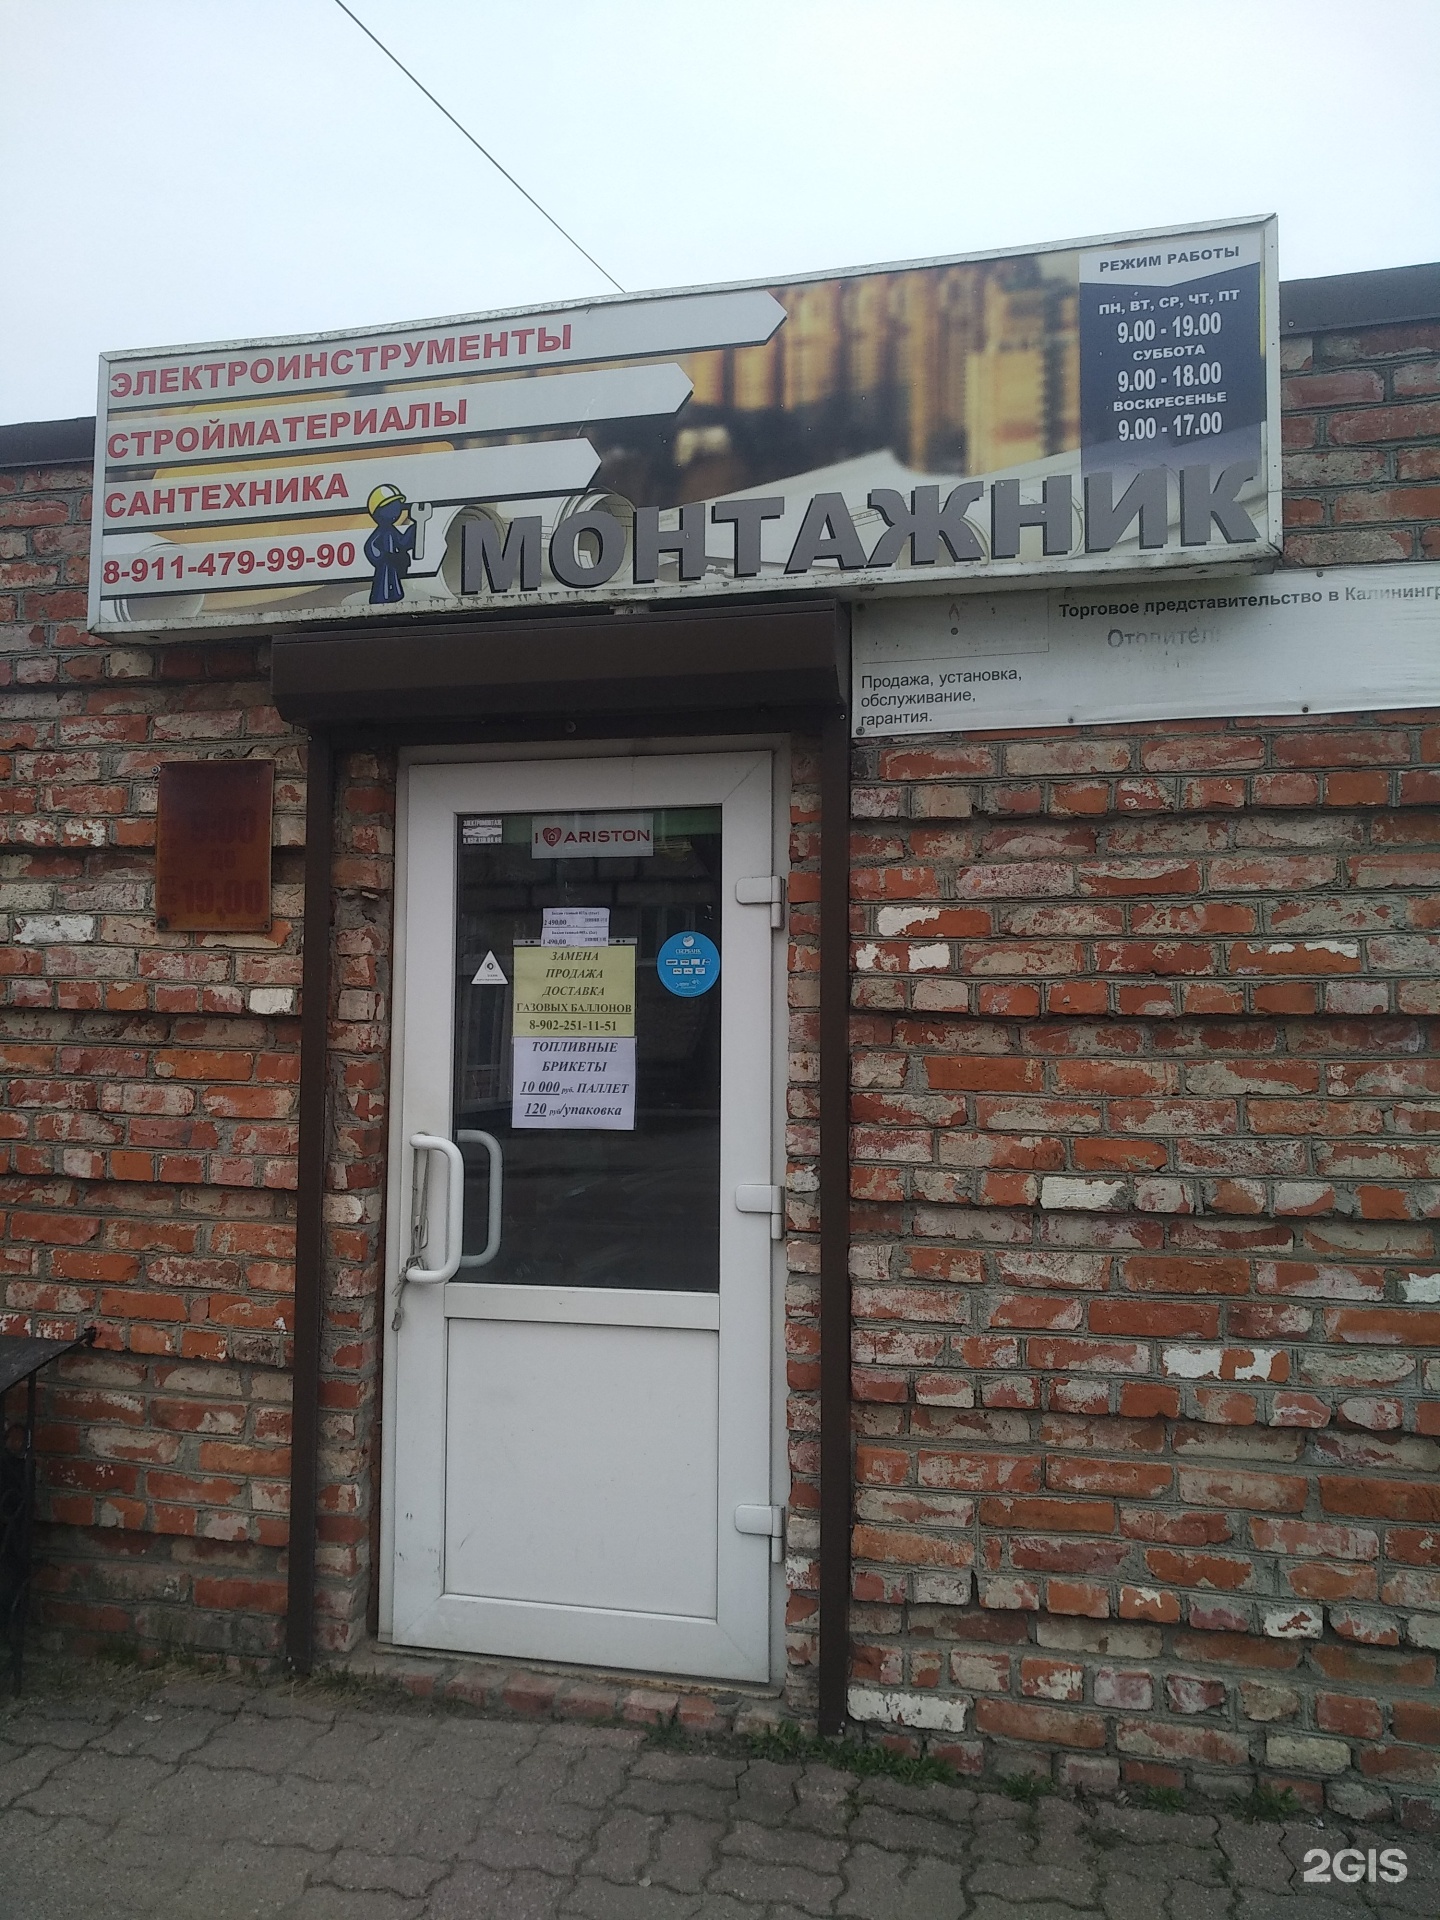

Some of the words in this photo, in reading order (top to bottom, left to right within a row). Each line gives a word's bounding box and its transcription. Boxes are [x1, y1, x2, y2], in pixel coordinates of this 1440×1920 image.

[1099, 254, 1162, 273] РЕЖИМ
[1167, 246, 1240, 265] РАБОТЫ
[1098, 303, 1126, 315] ПН,
[1130, 299, 1155, 312] ВТ,
[1158, 296, 1184, 309] СР,
[1188, 293, 1214, 305] ЧТ,
[1219, 289, 1241, 301] ПТ
[1117, 319, 1156, 344] 9.00
[1172, 311, 1222, 338] 19.00
[109, 323, 572, 399] ЭЛЕКТРОИНСТРУМЕНТЫ
[1132, 344, 1206, 361] СУББОТА
[1117, 368, 1156, 393] 9.00
[1172, 361, 1222, 387] 18.00
[1113, 391, 1228, 412] ВОСКРЕСЕНЬЕ
[107, 398, 468, 460] СТРОЙМАТЕРИАЛЫ
[1118, 417, 1157, 442] 9.00
[1172, 411, 1223, 437] 17.00
[104, 473, 349, 518] САНТЕХНИКА
[461, 462, 1262, 596] МОНТАЖНИК
[102, 541, 356, 585] 8-911-479-99-90
[1058, 602, 1140, 619] Торговое
[1143, 591, 1323, 615] представительство
[1329, 591, 1339, 602] в
[861, 673, 935, 690] Продажа,
[938, 668, 1022, 687] установка,
[861, 689, 977, 709] обслуживание,
[861, 711, 933, 727] гарантия.
[535, 832, 539, 845] I
[564, 829, 651, 844] ARISTON
[550, 951, 599, 962] ЗАМЕНА
[545, 968, 604, 980] ПРОДАЖА
[541, 985, 605, 998] ДОСТАВКА
[516, 1002, 568, 1013] ГАЗОВЫХ
[571, 1002, 632, 1013] БАЛЛОНОВ
[529, 1019, 617, 1032] 8-902-251-11-51
[532, 1041, 619, 1054] ТОПЛИВНЫЕ
[541, 1061, 608, 1073] БРИКЕТЫ
[577, 1083, 630, 1094] ПАЛЛЕТ
[524, 1102, 547, 1115] 120
